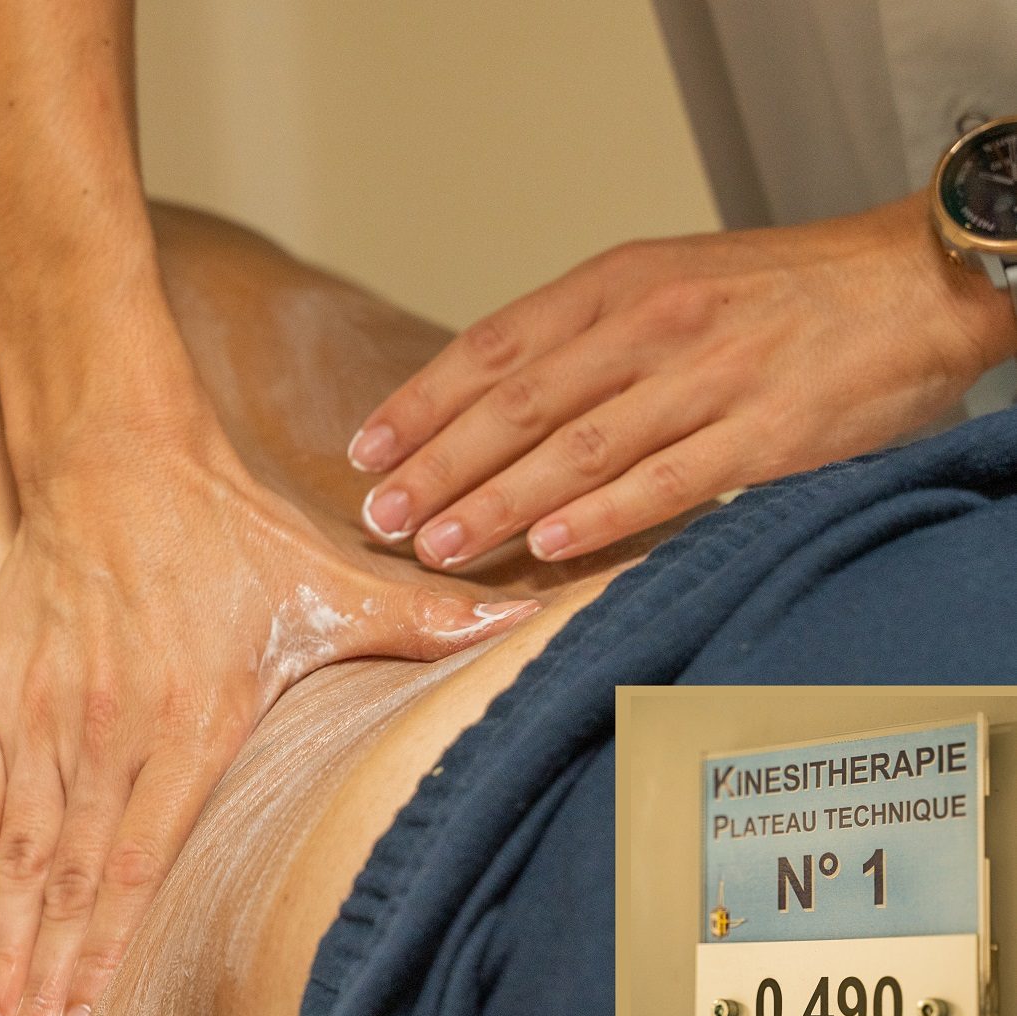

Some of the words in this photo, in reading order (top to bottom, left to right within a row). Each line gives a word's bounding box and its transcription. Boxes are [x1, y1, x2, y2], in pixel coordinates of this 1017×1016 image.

[713, 741, 967, 800] KINESITHERAPIE
[714, 809, 817, 840] PLATEAU
[824, 795, 967, 830] TECHNIQUE
[862, 848, 886, 908] 1
